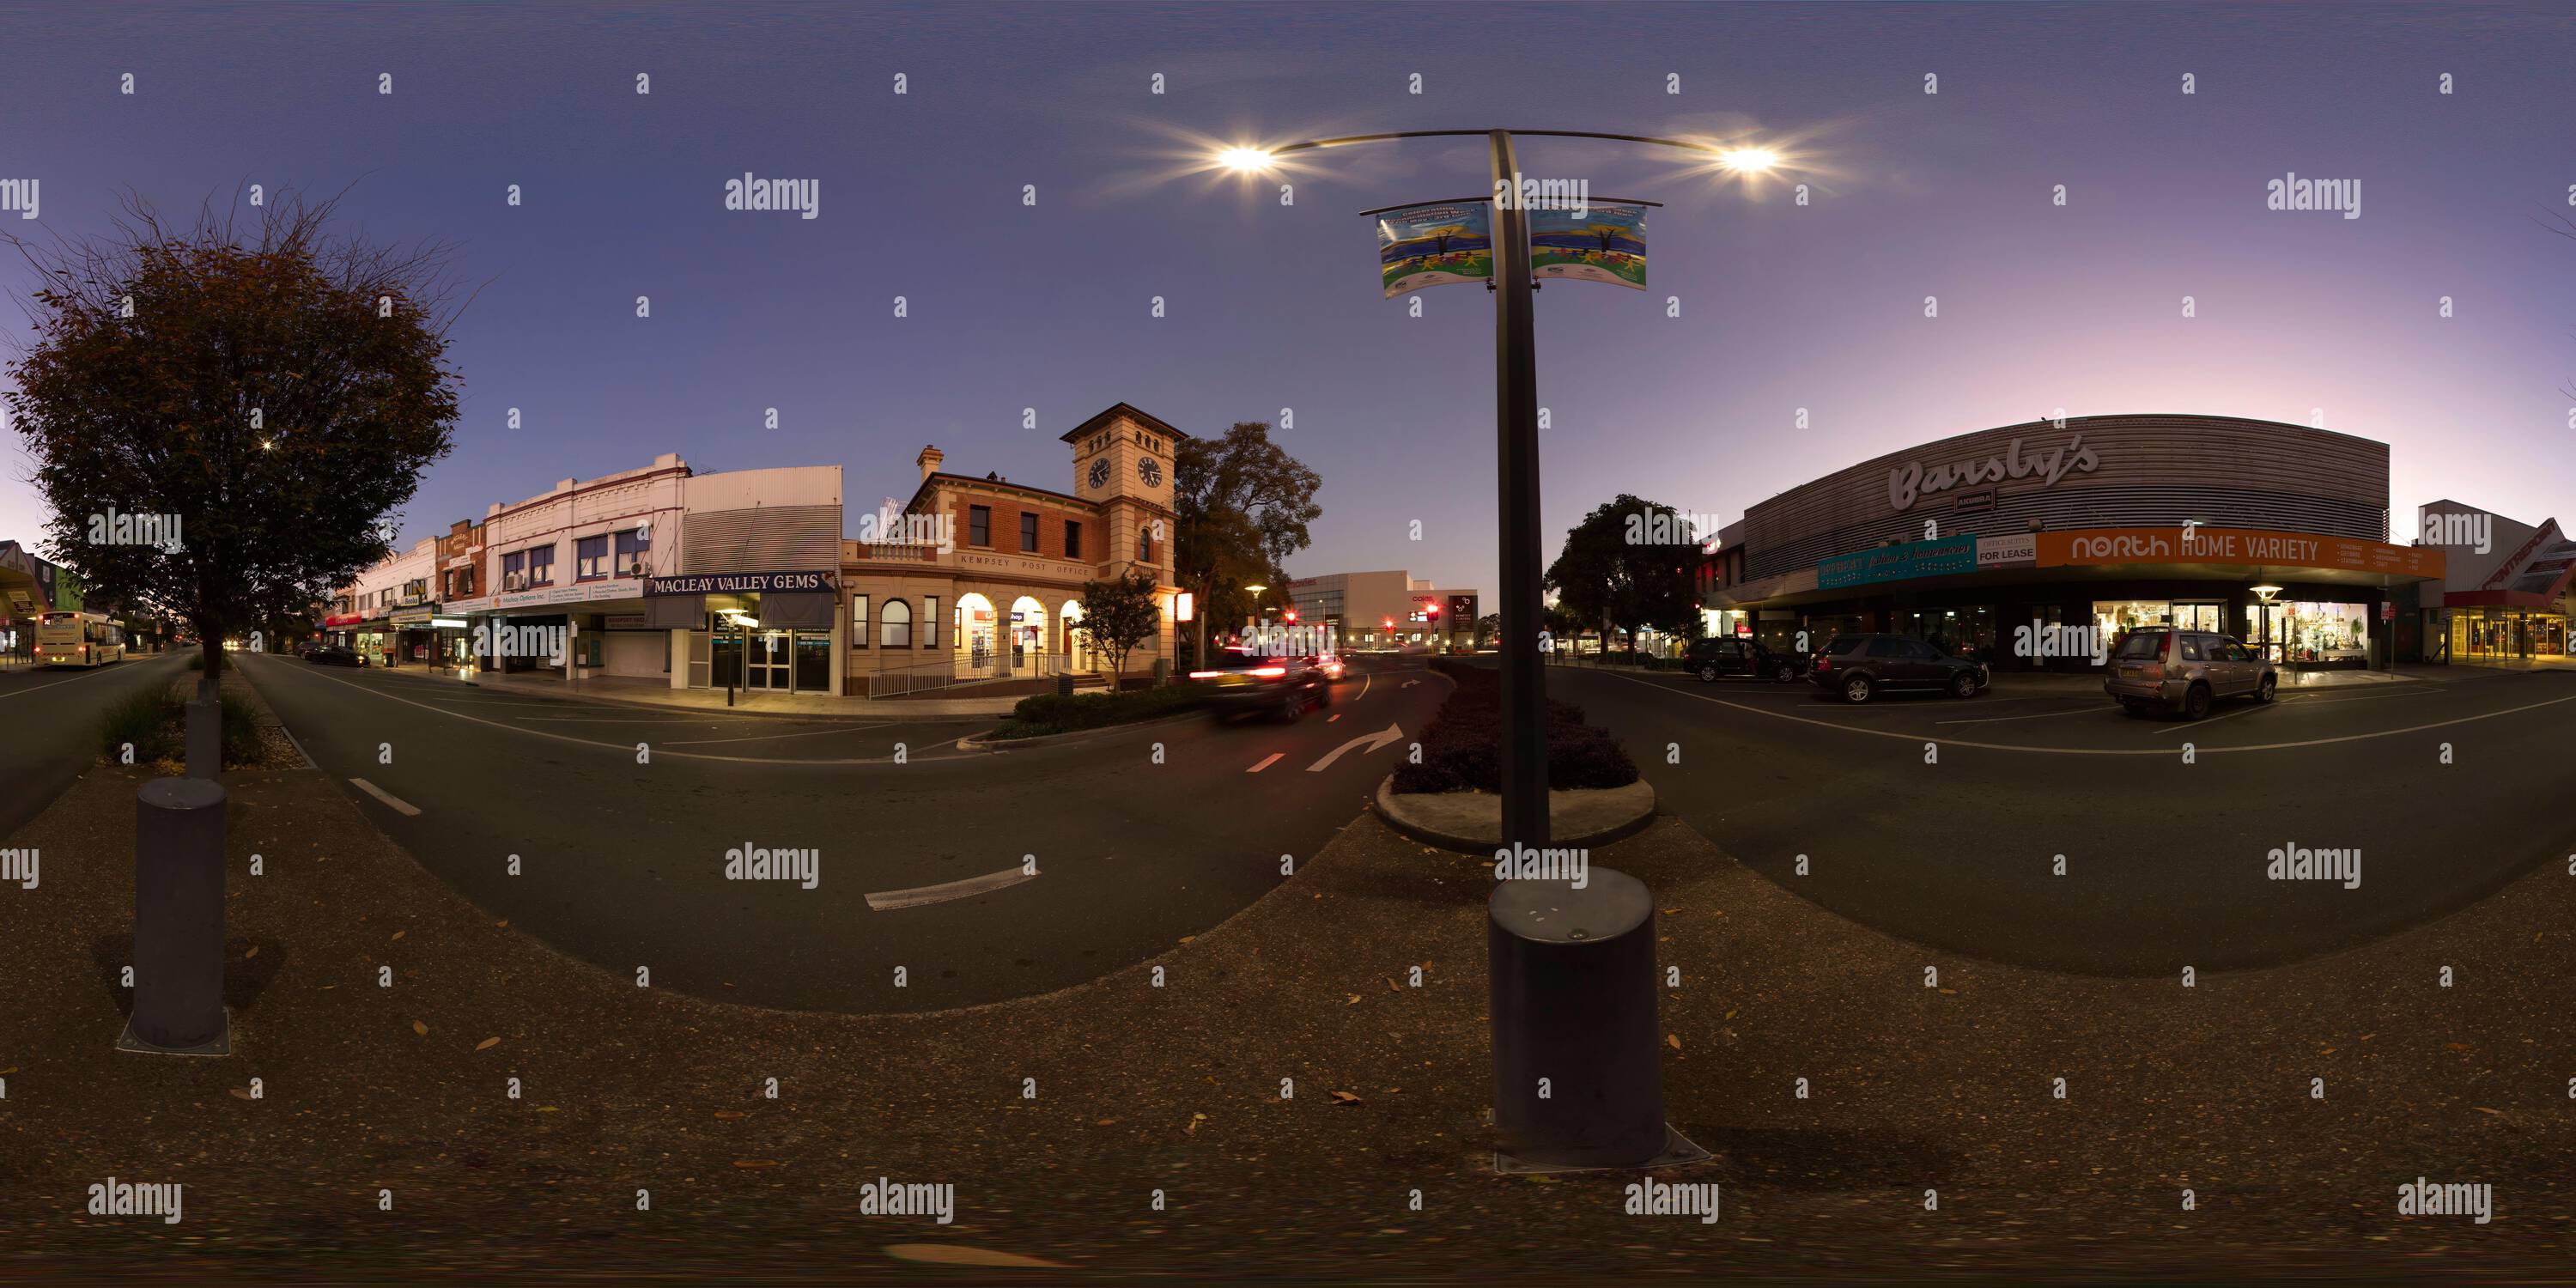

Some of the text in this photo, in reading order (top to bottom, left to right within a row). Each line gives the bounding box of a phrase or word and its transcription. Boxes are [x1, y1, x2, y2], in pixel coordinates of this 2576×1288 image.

[1888, 434, 2099, 511] Barsby's
[1979, 549, 2034, 561] FOR LEASE
[2181, 535, 2236, 557] HOME
[2245, 538, 2318, 562] VARIETY
[960, 556, 1090, 576] KEMPSEY POST OFFICE
[654, 574, 819, 593] MACLEAY VALLEY GEMS
[519, 593, 537, 602] Options
